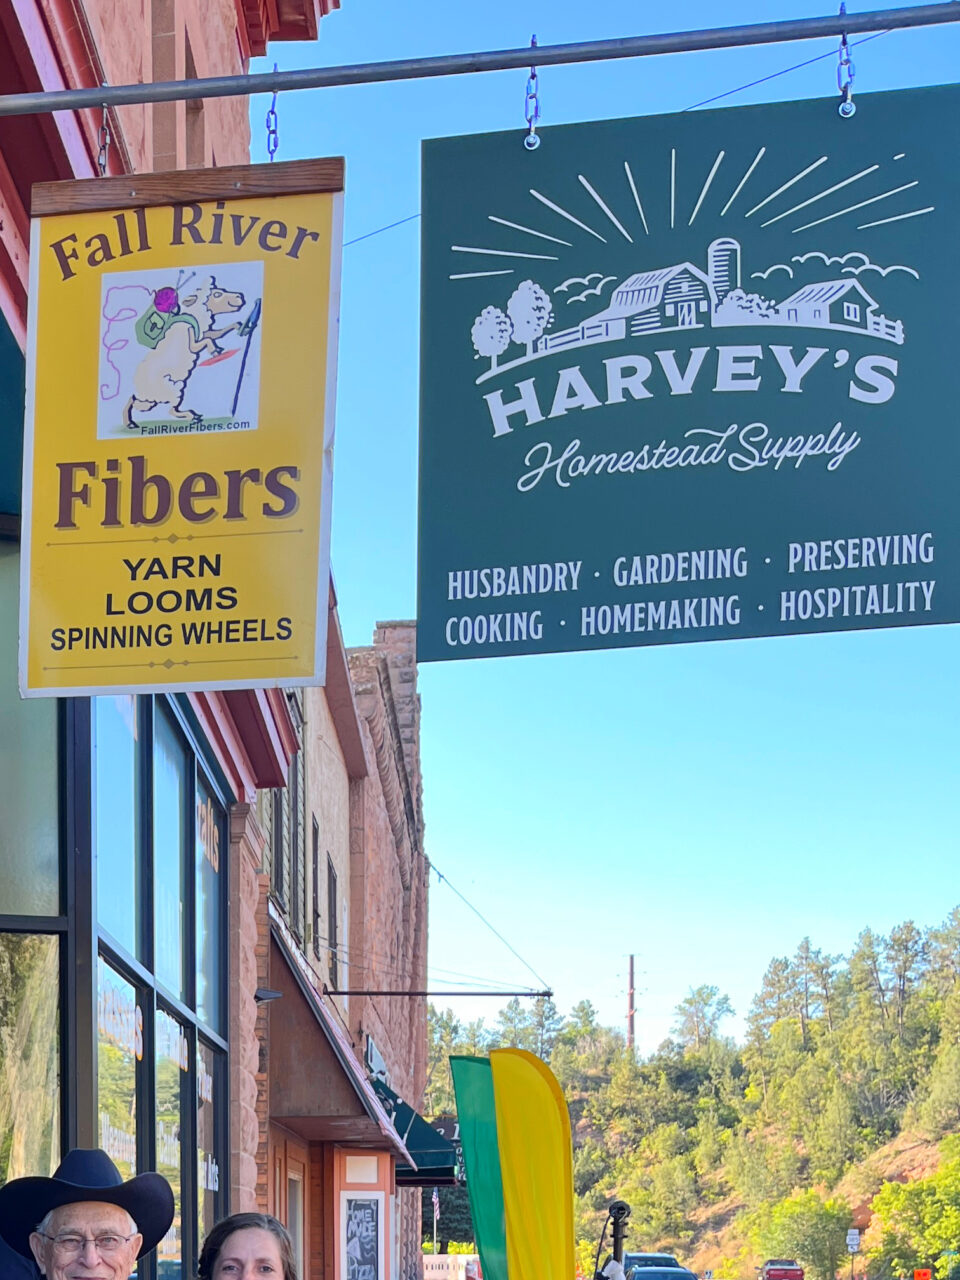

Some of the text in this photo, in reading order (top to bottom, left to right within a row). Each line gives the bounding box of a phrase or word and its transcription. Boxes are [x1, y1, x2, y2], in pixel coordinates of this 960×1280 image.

[50, 201, 320, 281] Fall River
[482, 344, 898, 438] HARVEY'S
[140, 419, 250, 437] FallRiverFibers.com
[517, 422, 861, 492] Homestead Supply
[54, 455, 301, 530] Fibers
[123, 553, 222, 582] YARN
[447, 532, 934, 600] HUSBANDRY GARDENING PRESERVING
[51, 616, 293, 651] SPINNING WHEELS
[105, 586, 238, 616] LOOMS
[445, 580, 936, 646] COOKING HOMEMAKING HOSPITALITY
